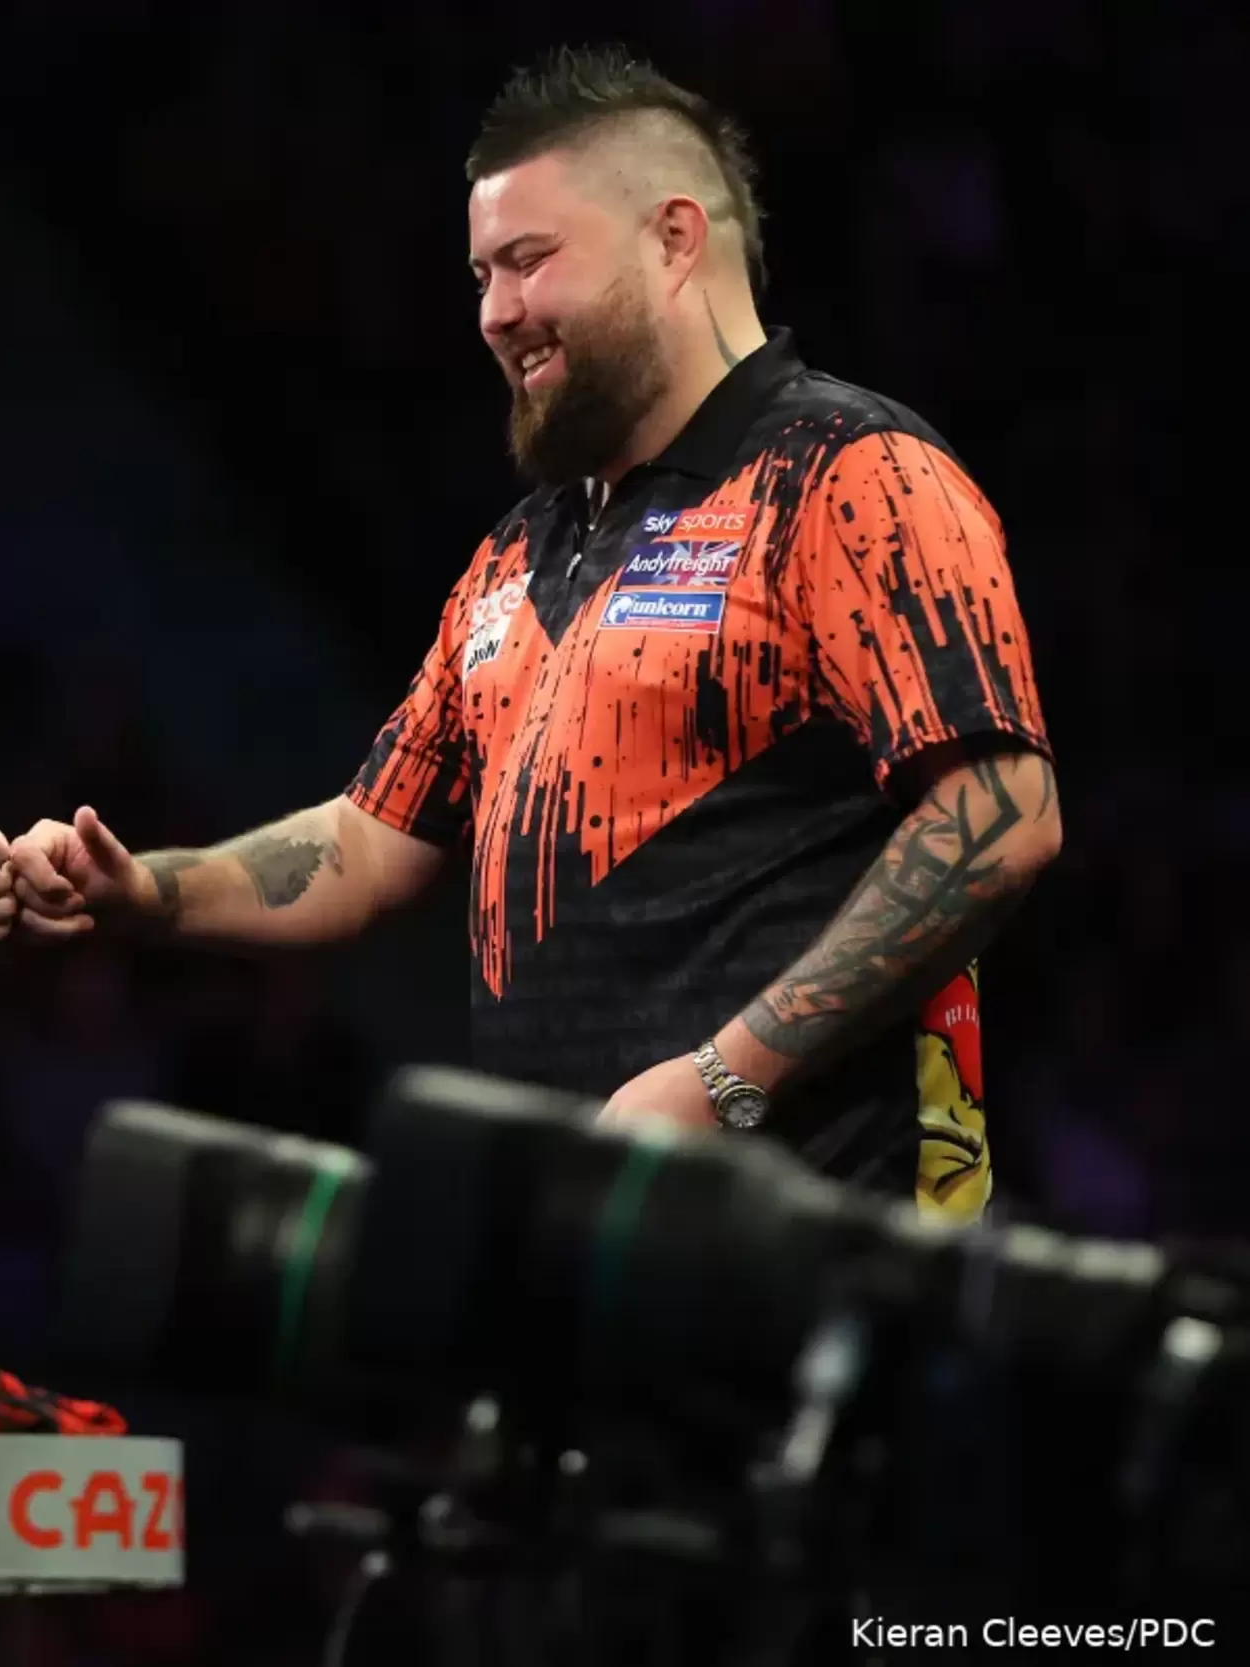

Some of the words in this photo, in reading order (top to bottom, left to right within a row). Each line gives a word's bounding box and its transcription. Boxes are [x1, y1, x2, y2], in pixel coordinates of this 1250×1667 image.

[644, 513, 678, 534] sky
[679, 512, 747, 532] sports
[625, 550, 731, 577] Andyfreight
[629, 597, 709, 617] unicorn
[8, 1470, 185, 1552] CAZ
